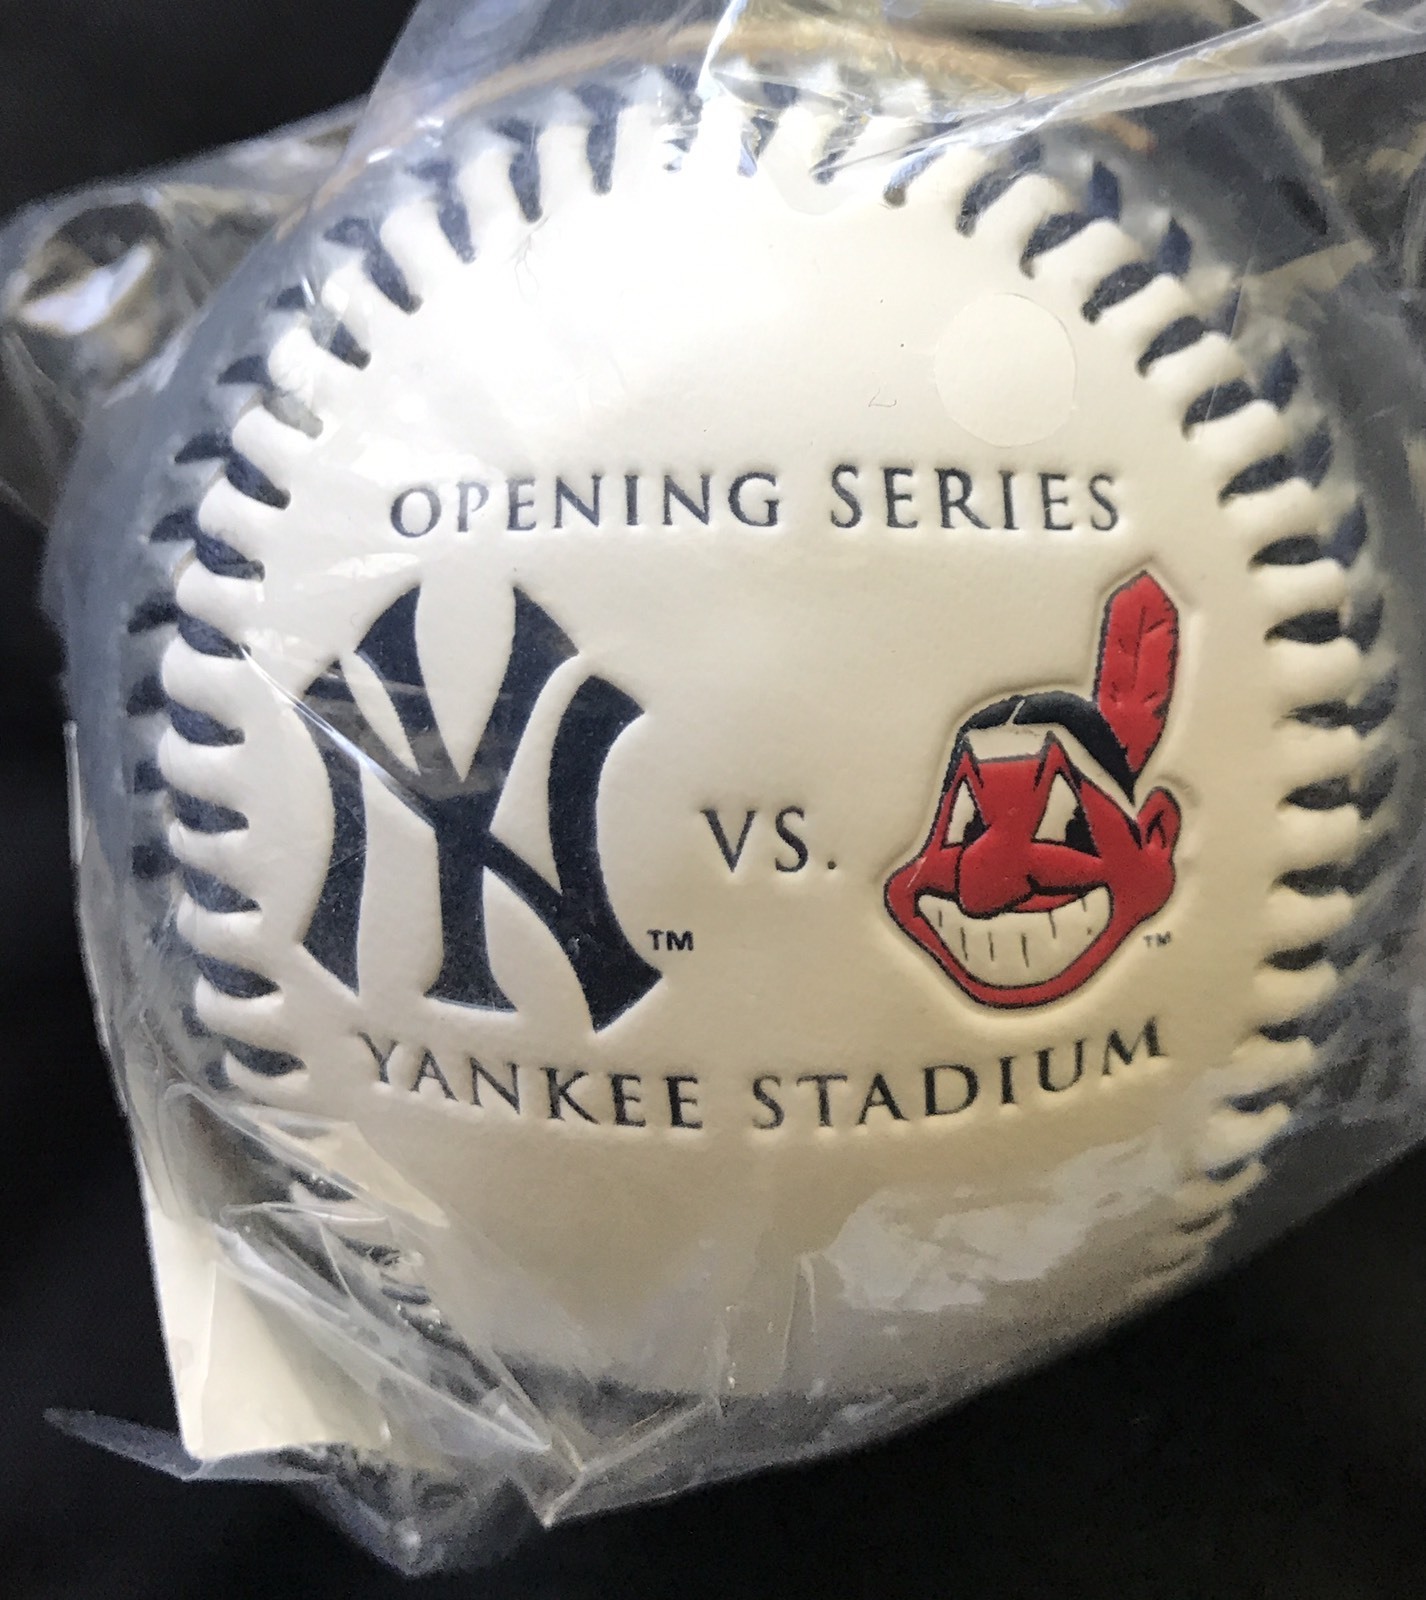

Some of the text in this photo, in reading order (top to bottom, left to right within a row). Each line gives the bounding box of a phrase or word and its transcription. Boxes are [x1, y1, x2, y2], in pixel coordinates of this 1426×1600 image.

[389, 463, 1121, 539] OPENING SERIES
[701, 805, 839, 874] VS.
[647, 929, 695, 952] TM
[356, 1016, 1168, 1131] YANKEE STADIUM
